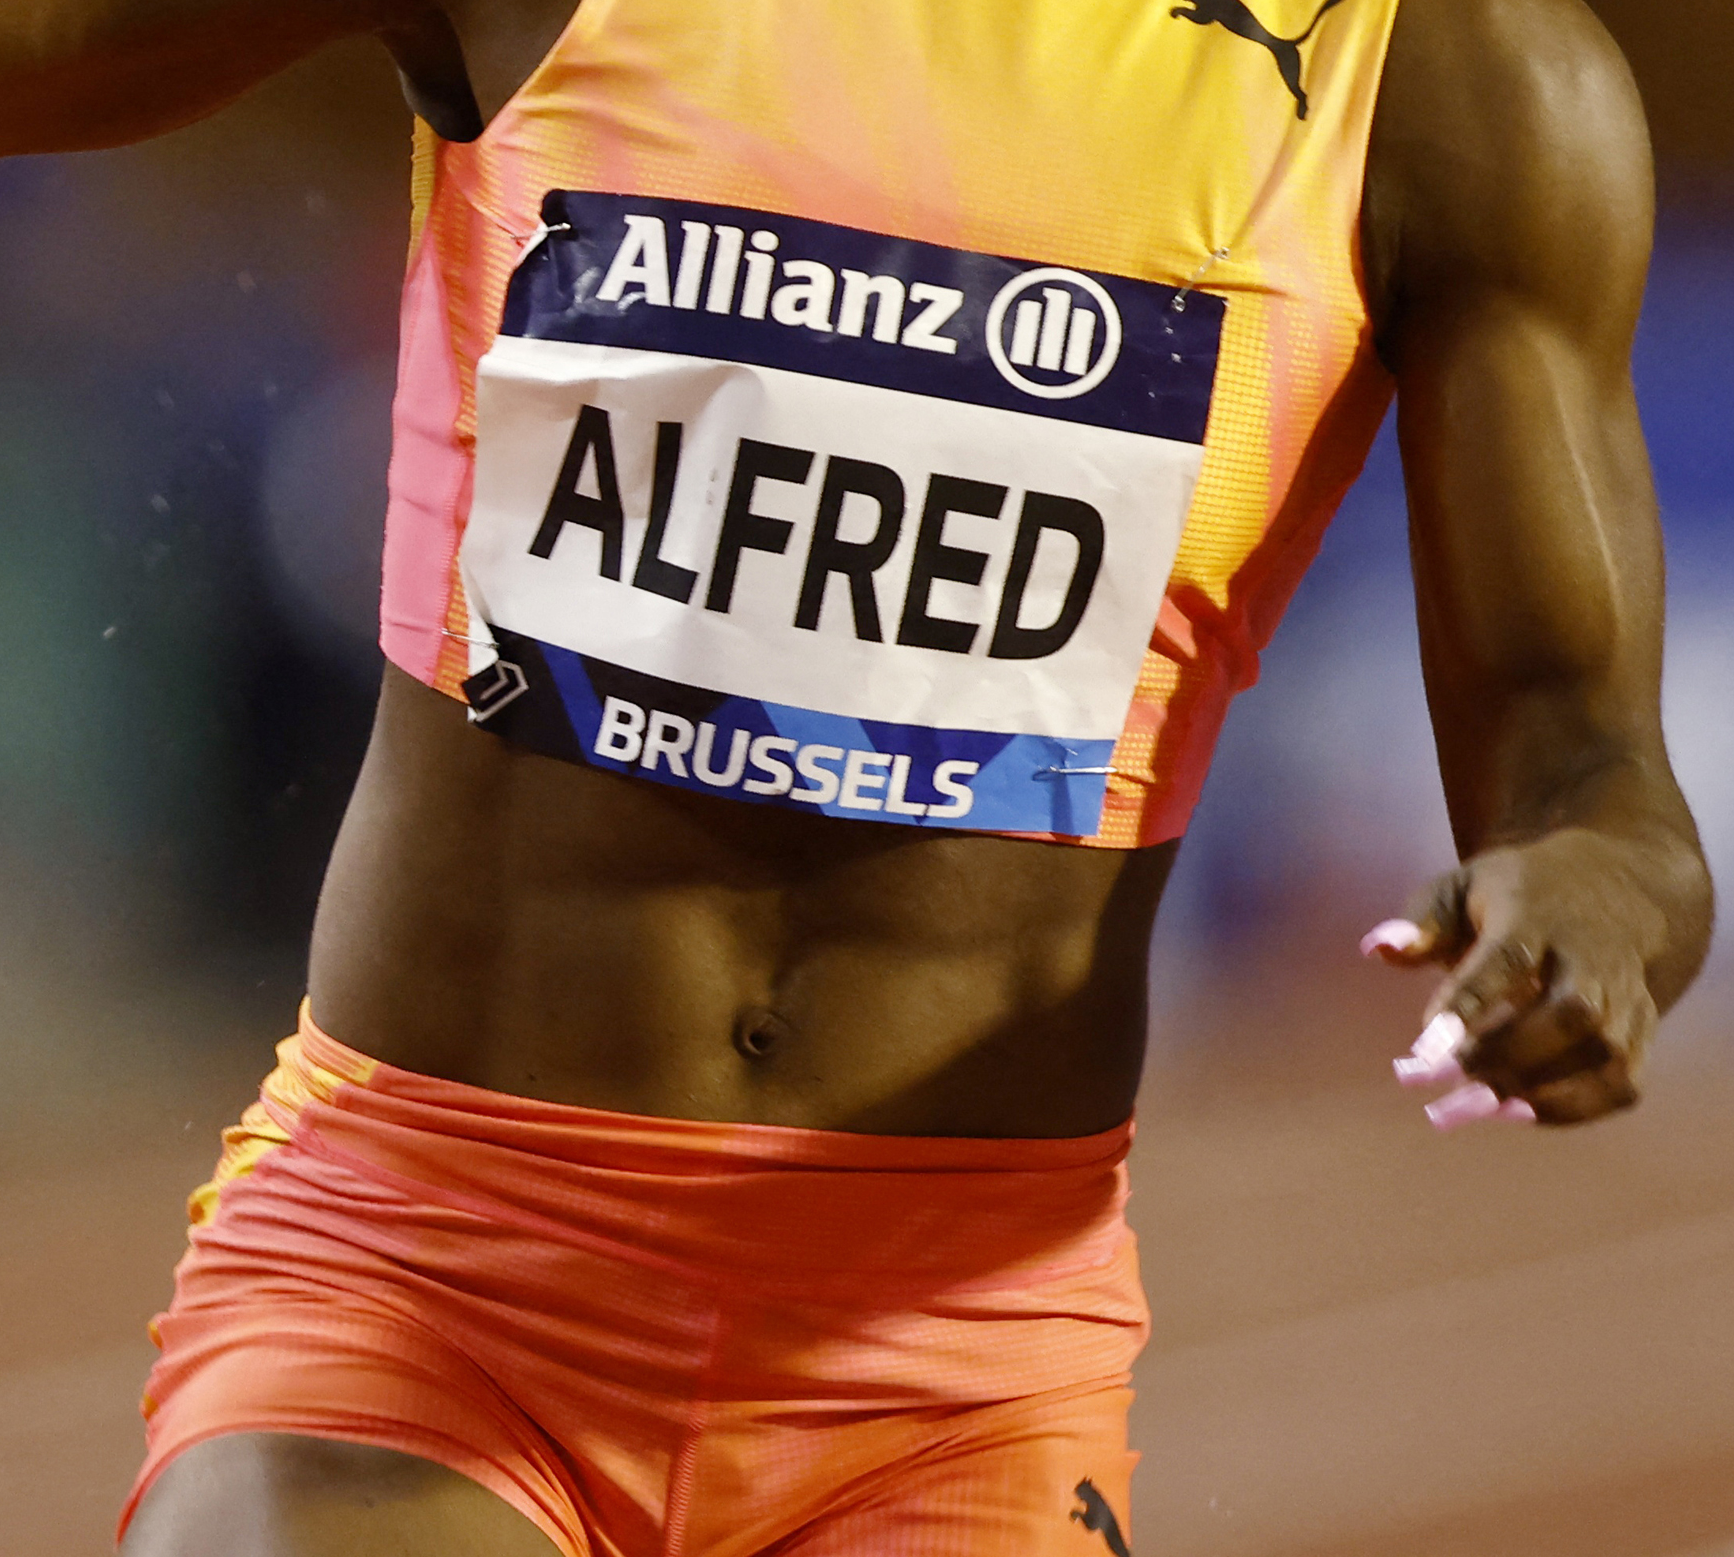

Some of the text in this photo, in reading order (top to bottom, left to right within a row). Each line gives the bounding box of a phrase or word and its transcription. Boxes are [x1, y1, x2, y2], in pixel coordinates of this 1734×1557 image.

[595, 212, 966, 355] Allianz
[527, 403, 1107, 661] ALFRED
[592, 694, 981, 820] BRUSSELS
